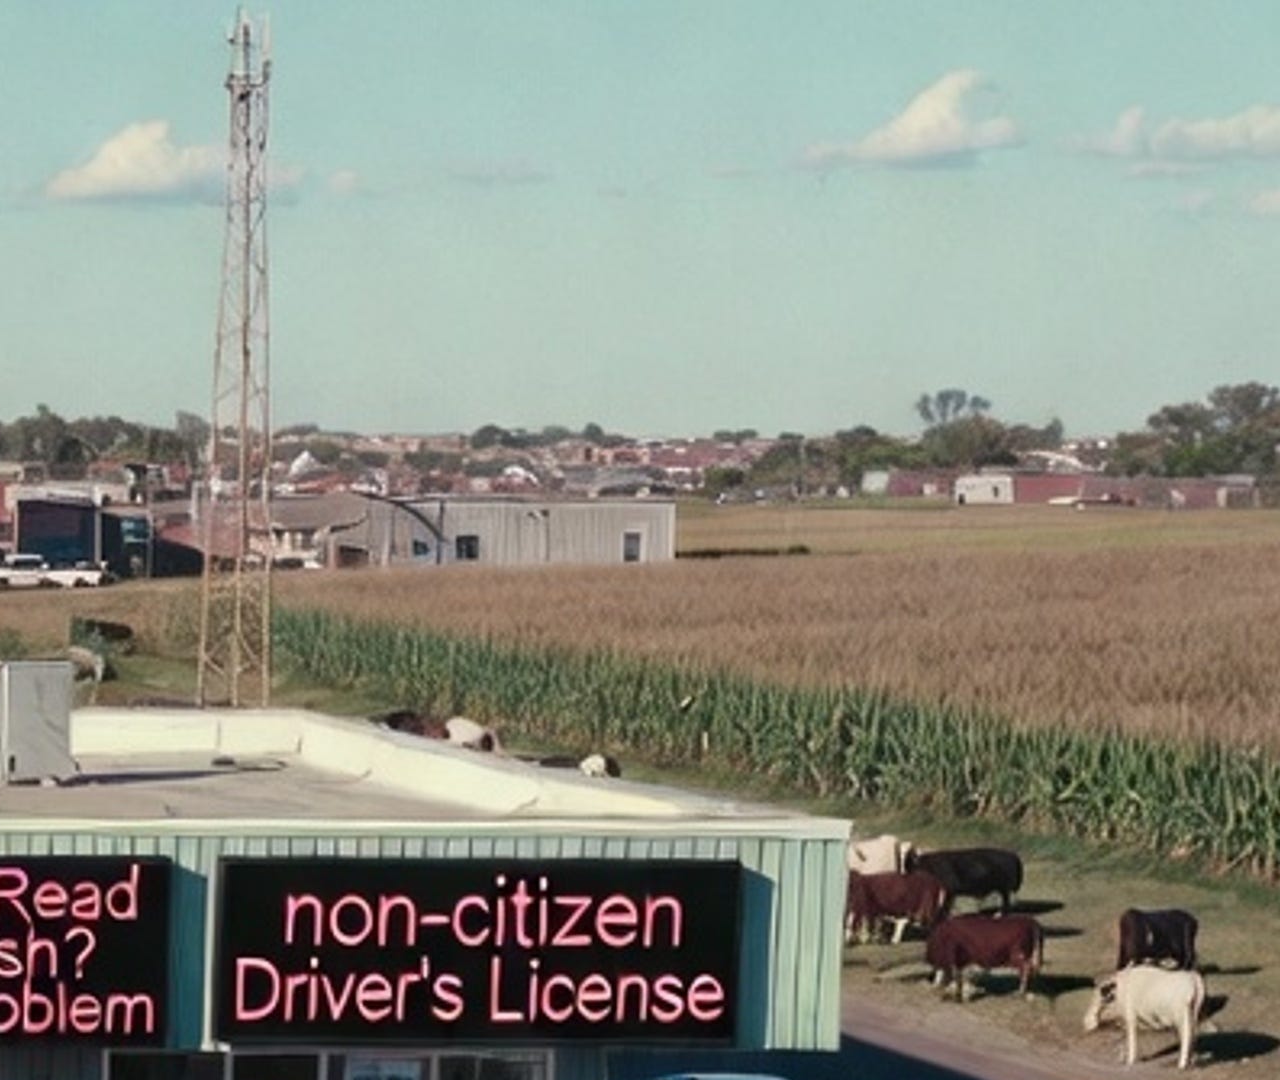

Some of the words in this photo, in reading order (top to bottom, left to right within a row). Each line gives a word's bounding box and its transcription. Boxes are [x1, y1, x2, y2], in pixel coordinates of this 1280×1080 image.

[284, 875, 683, 949] non-citizen
[235, 956, 464, 1022] Driver's
[490, 956, 726, 1023] License
